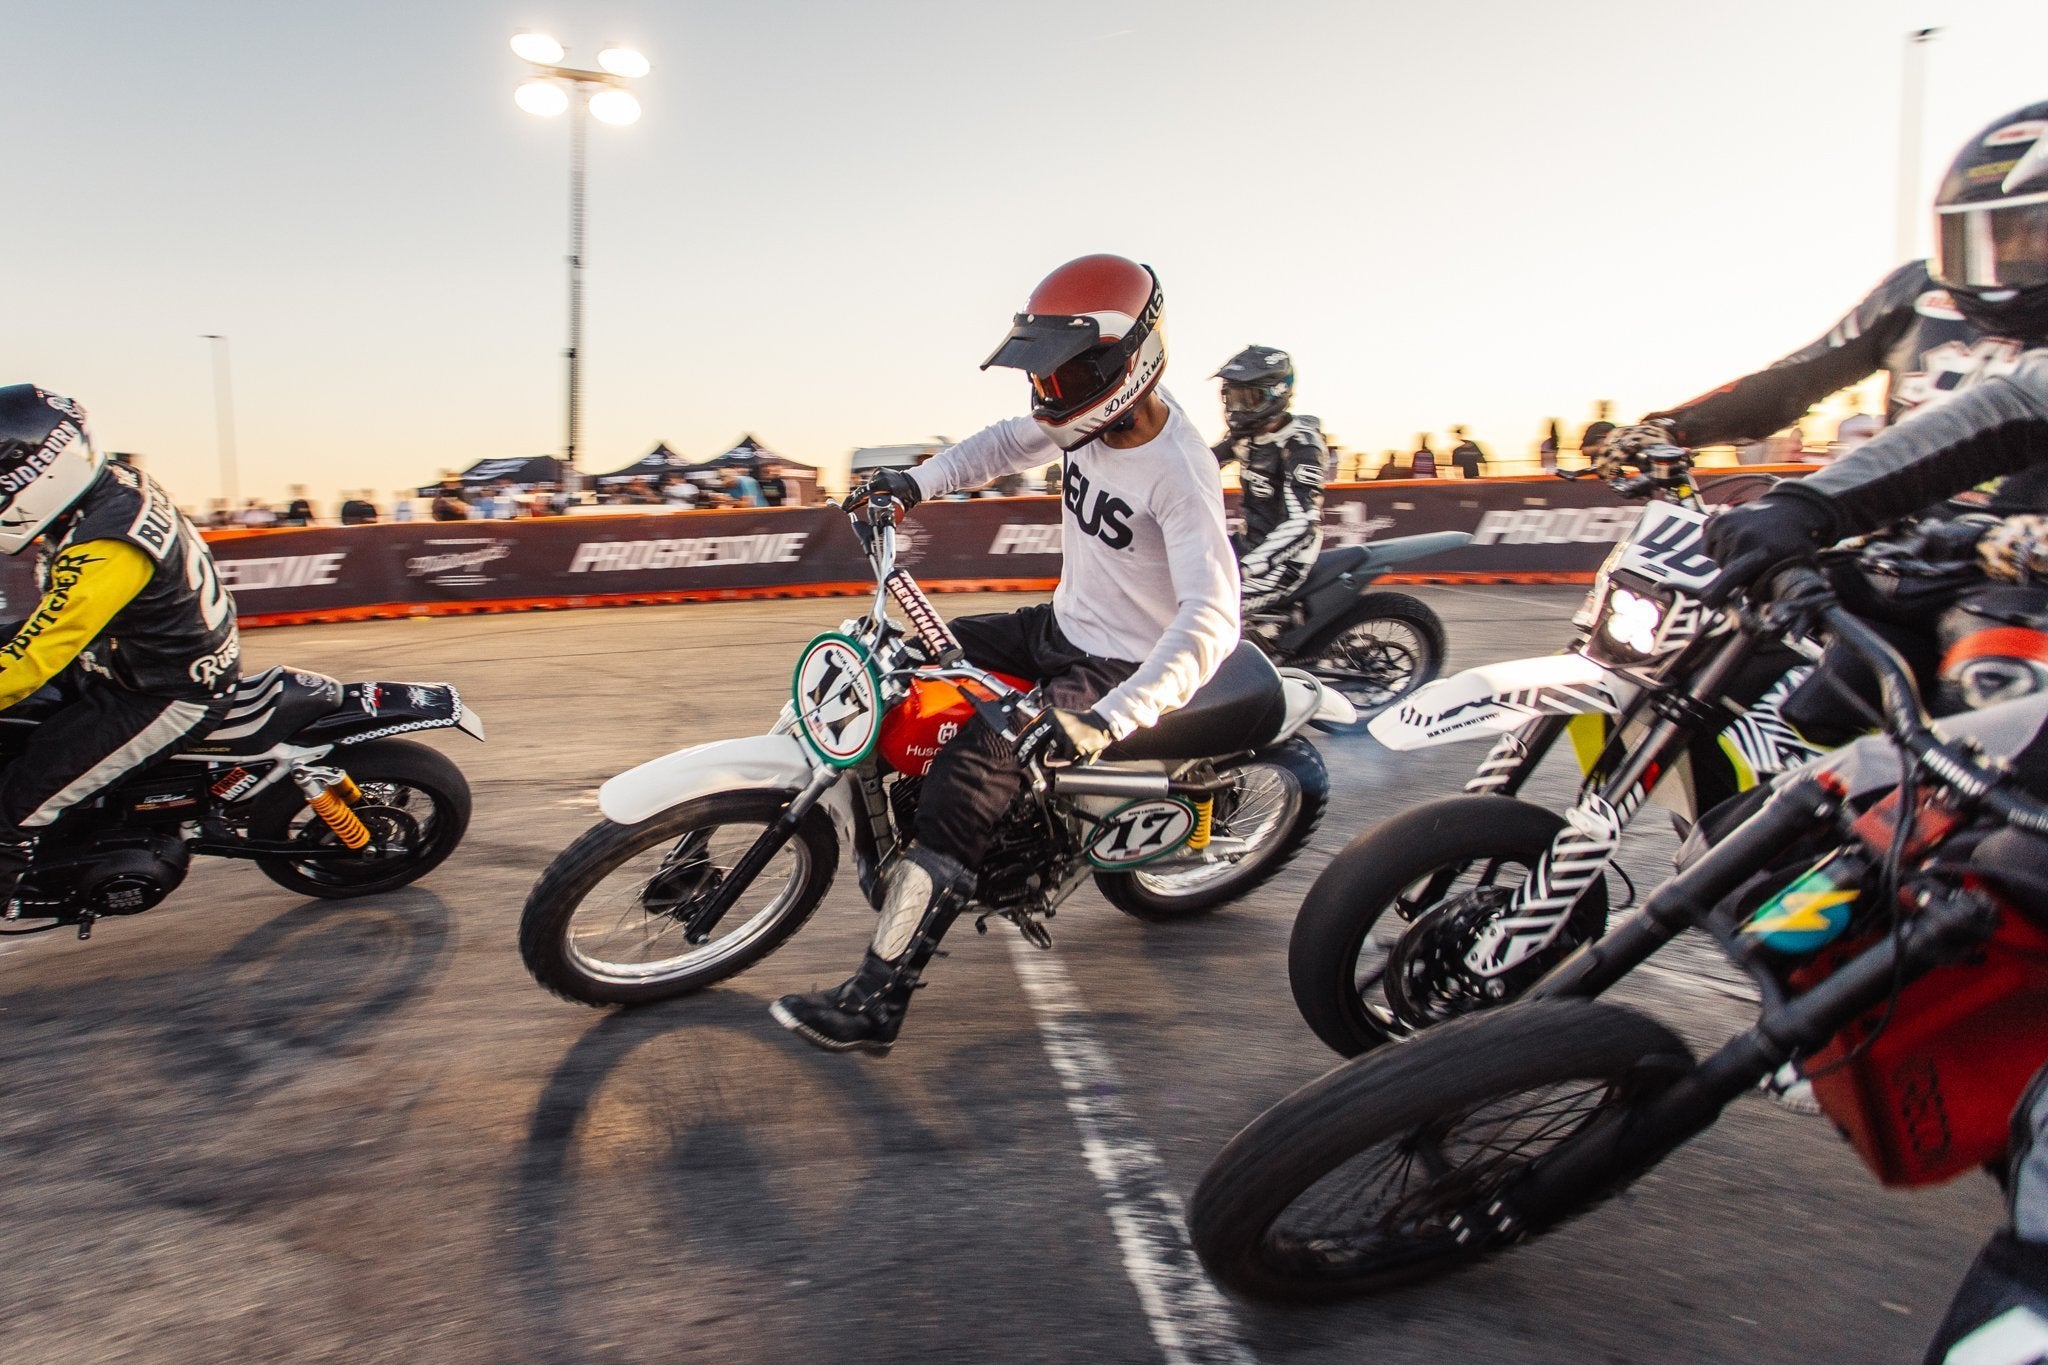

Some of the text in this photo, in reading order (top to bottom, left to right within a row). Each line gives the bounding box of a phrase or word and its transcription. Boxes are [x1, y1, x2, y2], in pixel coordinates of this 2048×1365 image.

[0, 420, 80, 492] SIDEBURN
[887, 576, 948, 653] RENTHAL
[210, 767, 246, 795] VIRUS
[219, 774, 259, 801] MOTO
[1107, 810, 1181, 854] 17
